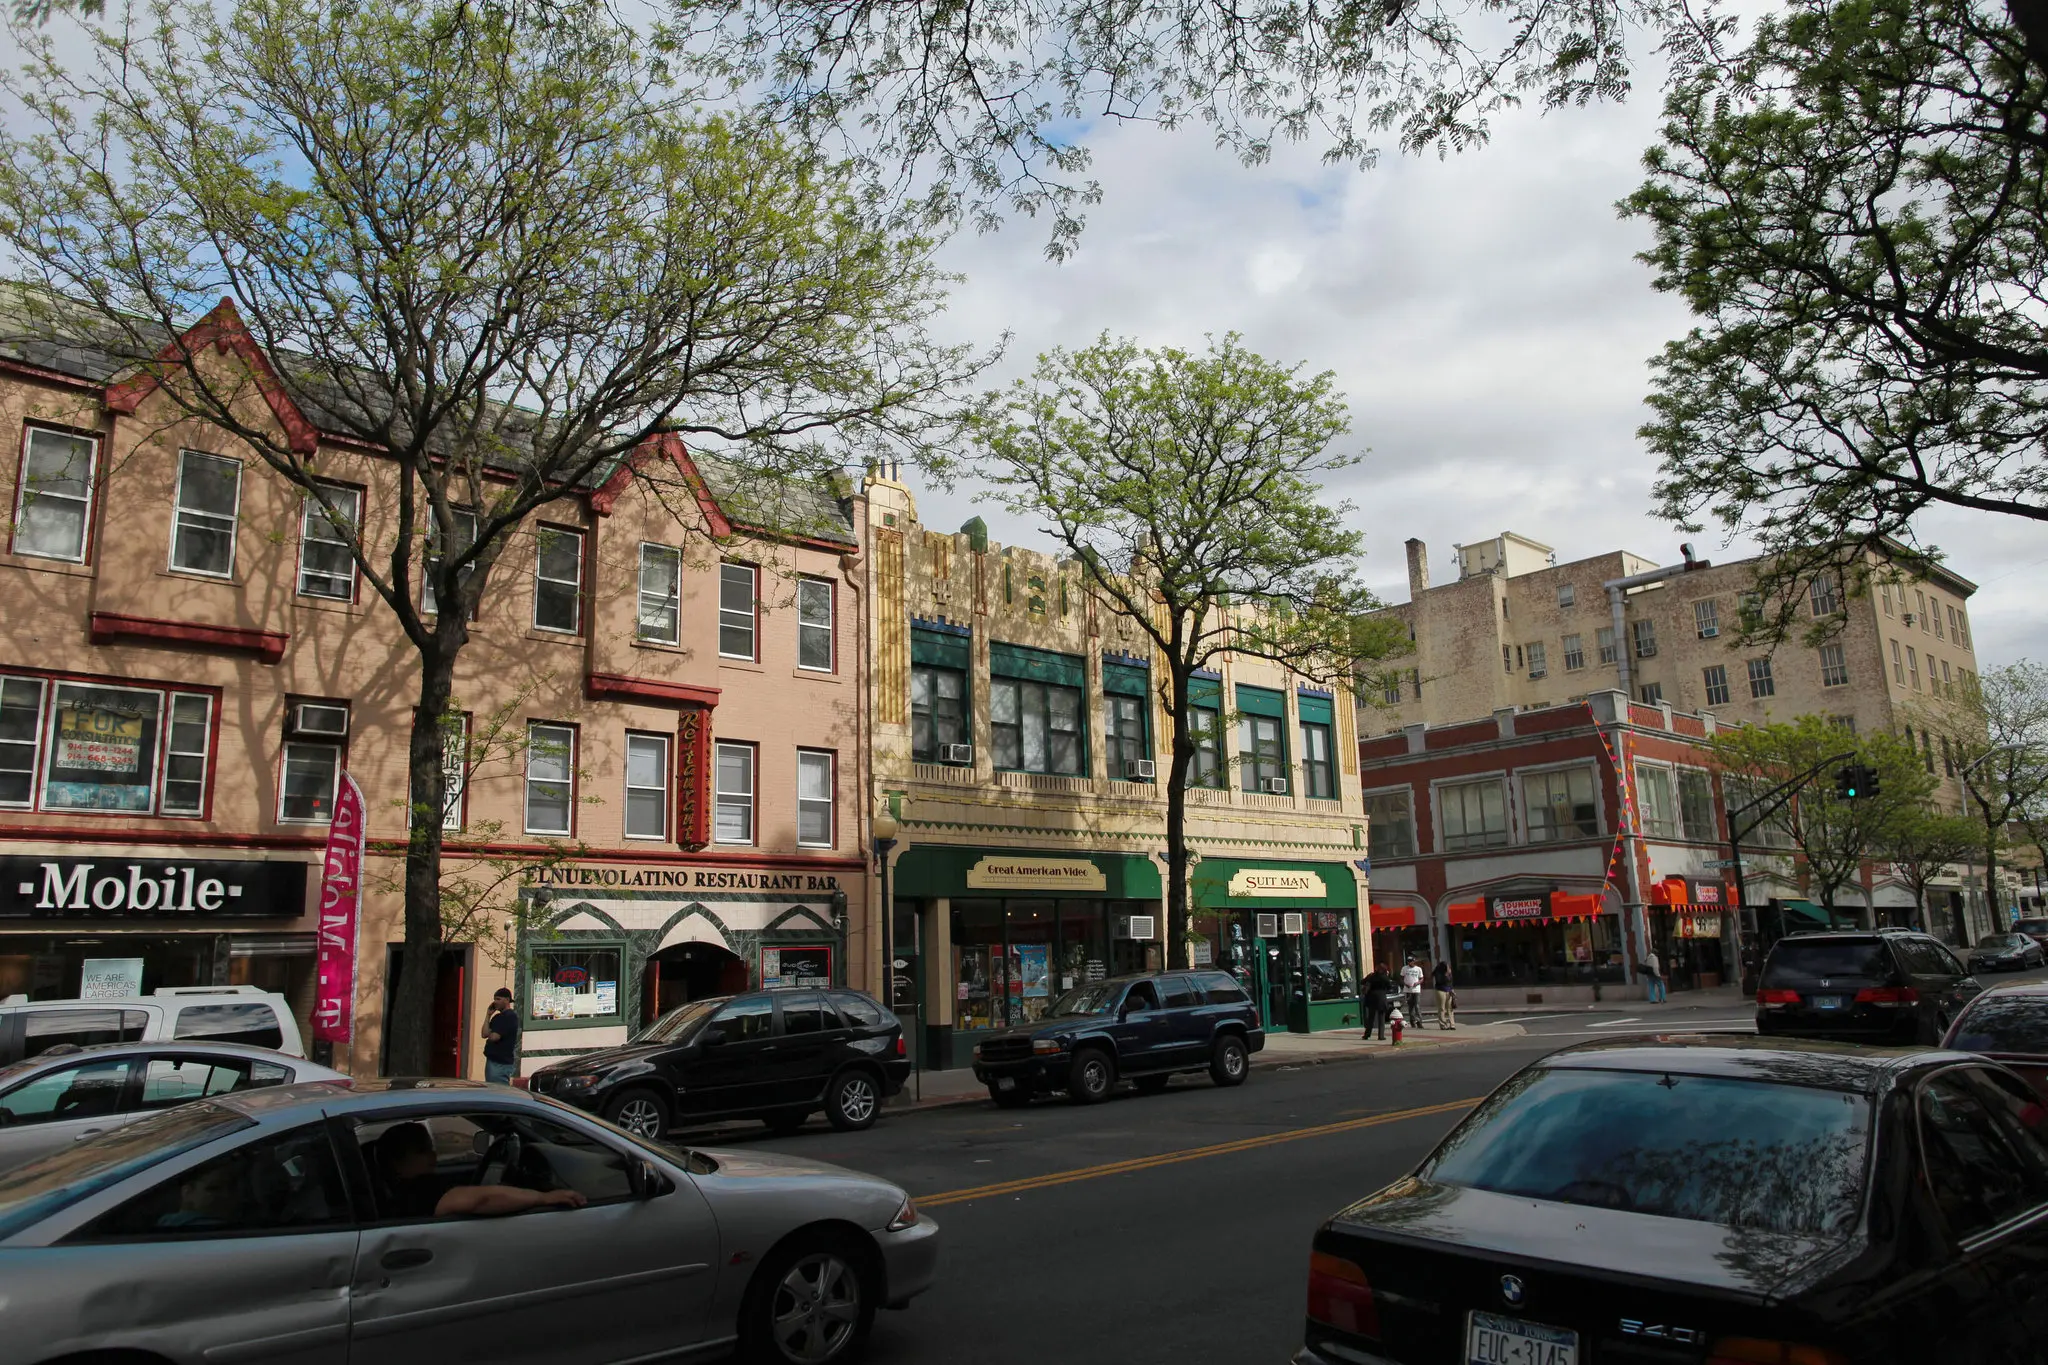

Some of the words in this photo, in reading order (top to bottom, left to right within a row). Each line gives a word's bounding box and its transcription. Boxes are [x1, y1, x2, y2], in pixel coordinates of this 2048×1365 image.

[75, 709, 126, 733] FOR
[987, 864, 1014, 876] Great
[1016, 866, 1062, 877] American
[1063, 867, 1089, 877] Video
[694, 871, 803, 890] RESTAURANT
[806, 876, 838, 891] BAR
[1245, 876, 1277, 890] SUIT
[1280, 877, 1310, 890] MAN
[1506, 899, 1542, 909] DUNKIN'
[1506, 908, 1541, 917] DONUTS
[86, 973, 102, 982] WE
[105, 973, 125, 982] ARE
[554, 969, 589, 984] OPEN
[84, 989, 130, 999] LARGEST
[1618, 1317, 1707, 1347] 540i
[1477, 1329, 1510, 1363] EUC
